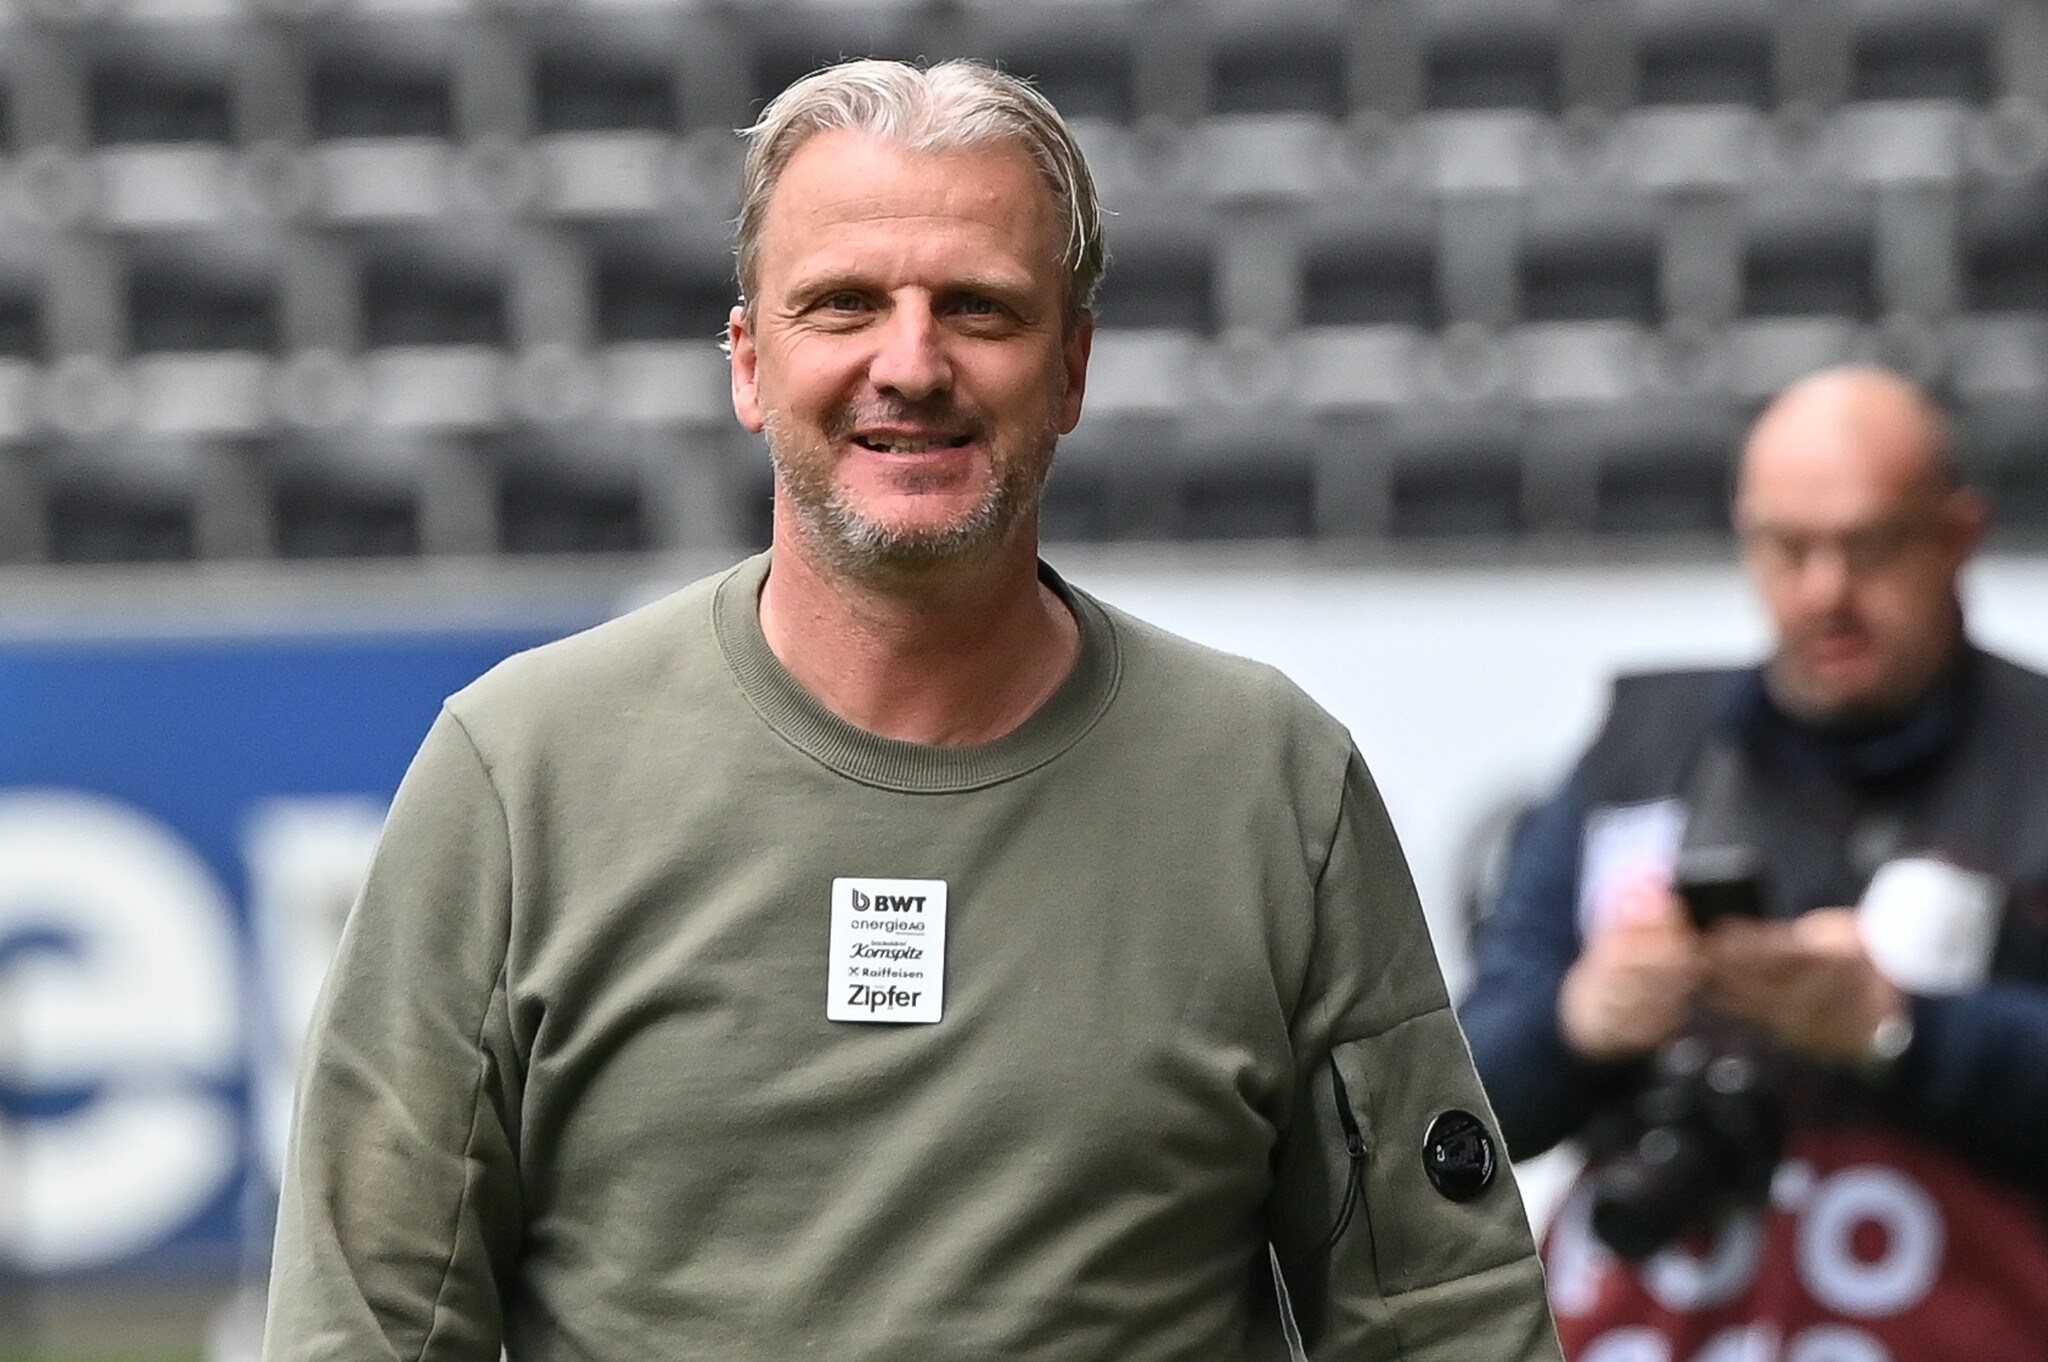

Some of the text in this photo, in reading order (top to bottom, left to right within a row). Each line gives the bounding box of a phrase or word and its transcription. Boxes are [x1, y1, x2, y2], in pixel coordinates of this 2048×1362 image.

[874, 895, 927, 913] BWT
[849, 942, 924, 962] Kornspitz
[861, 967, 924, 979] Raiffeisen
[847, 983, 922, 1013] Zipfer
